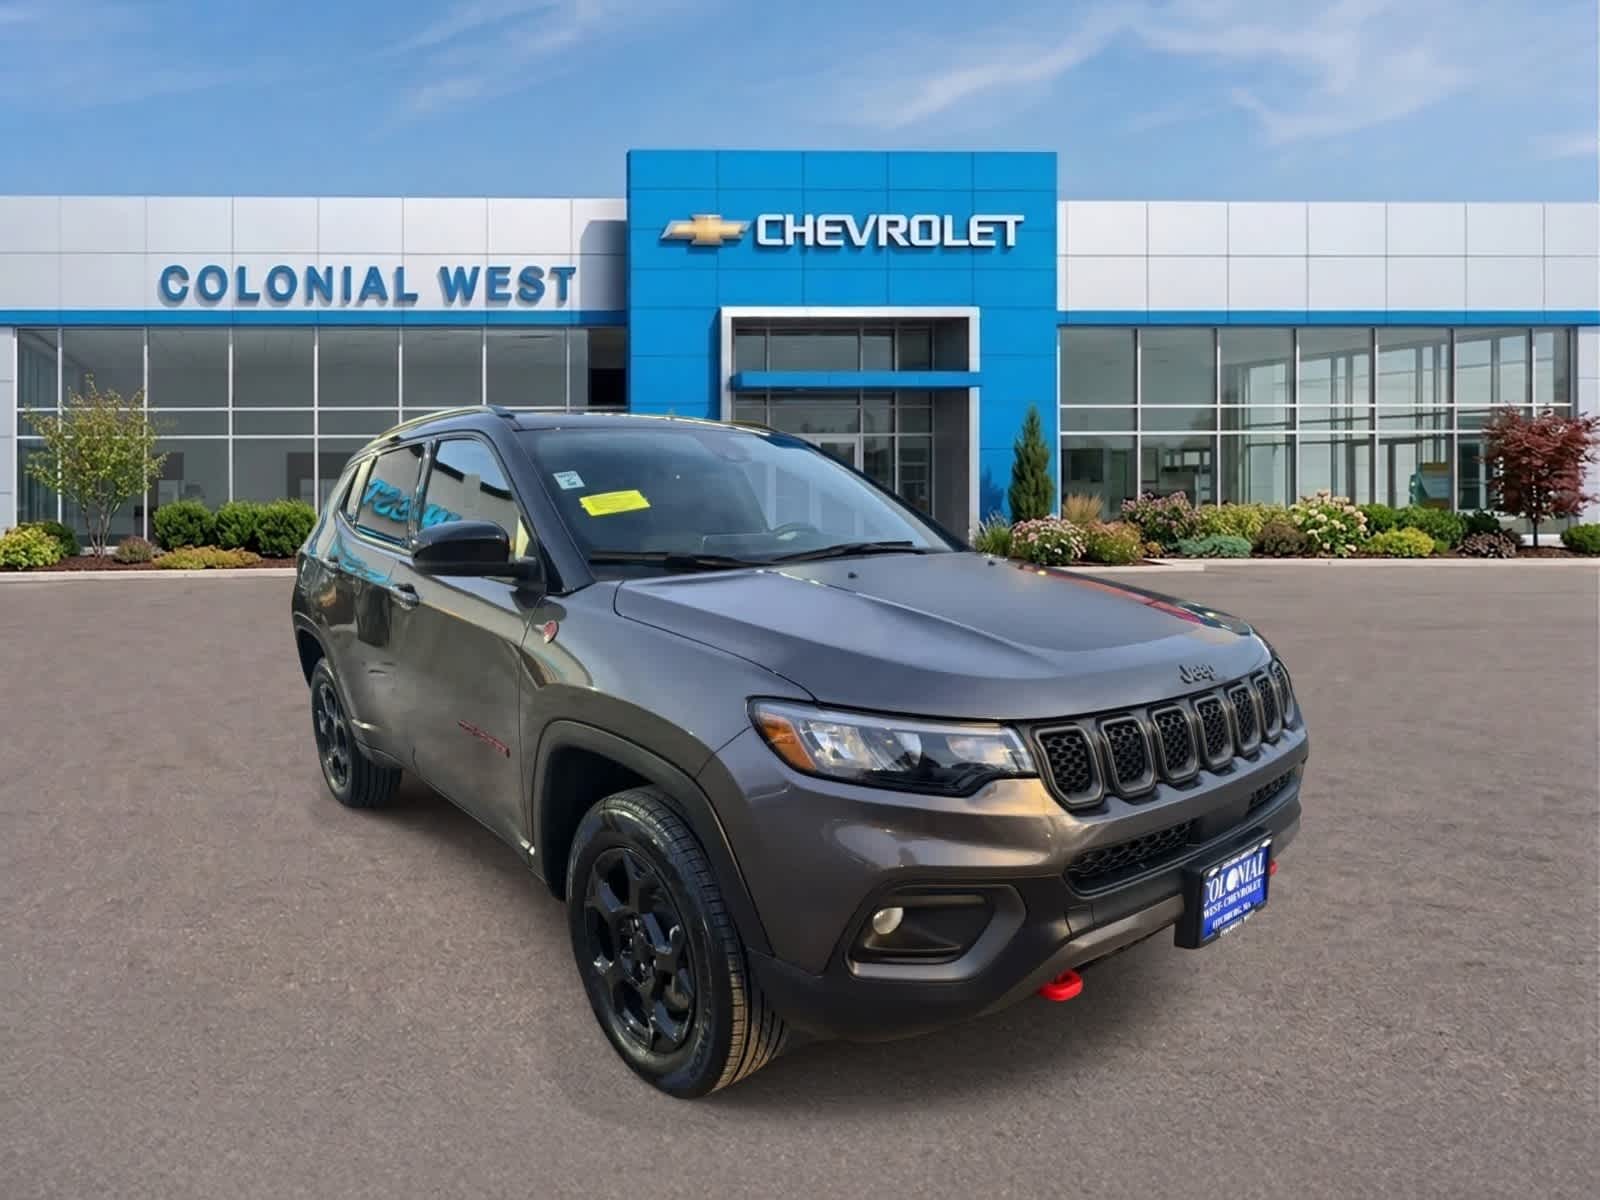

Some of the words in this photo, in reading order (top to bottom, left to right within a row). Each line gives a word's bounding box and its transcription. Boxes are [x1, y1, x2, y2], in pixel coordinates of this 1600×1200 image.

[756, 213, 1025, 248] CHEVROLET
[159, 264, 418, 304] COLONIAL
[439, 265, 577, 304] WEST
[1179, 664, 1215, 685] Jeep
[1224, 878, 1262, 908] CHEVROLET
